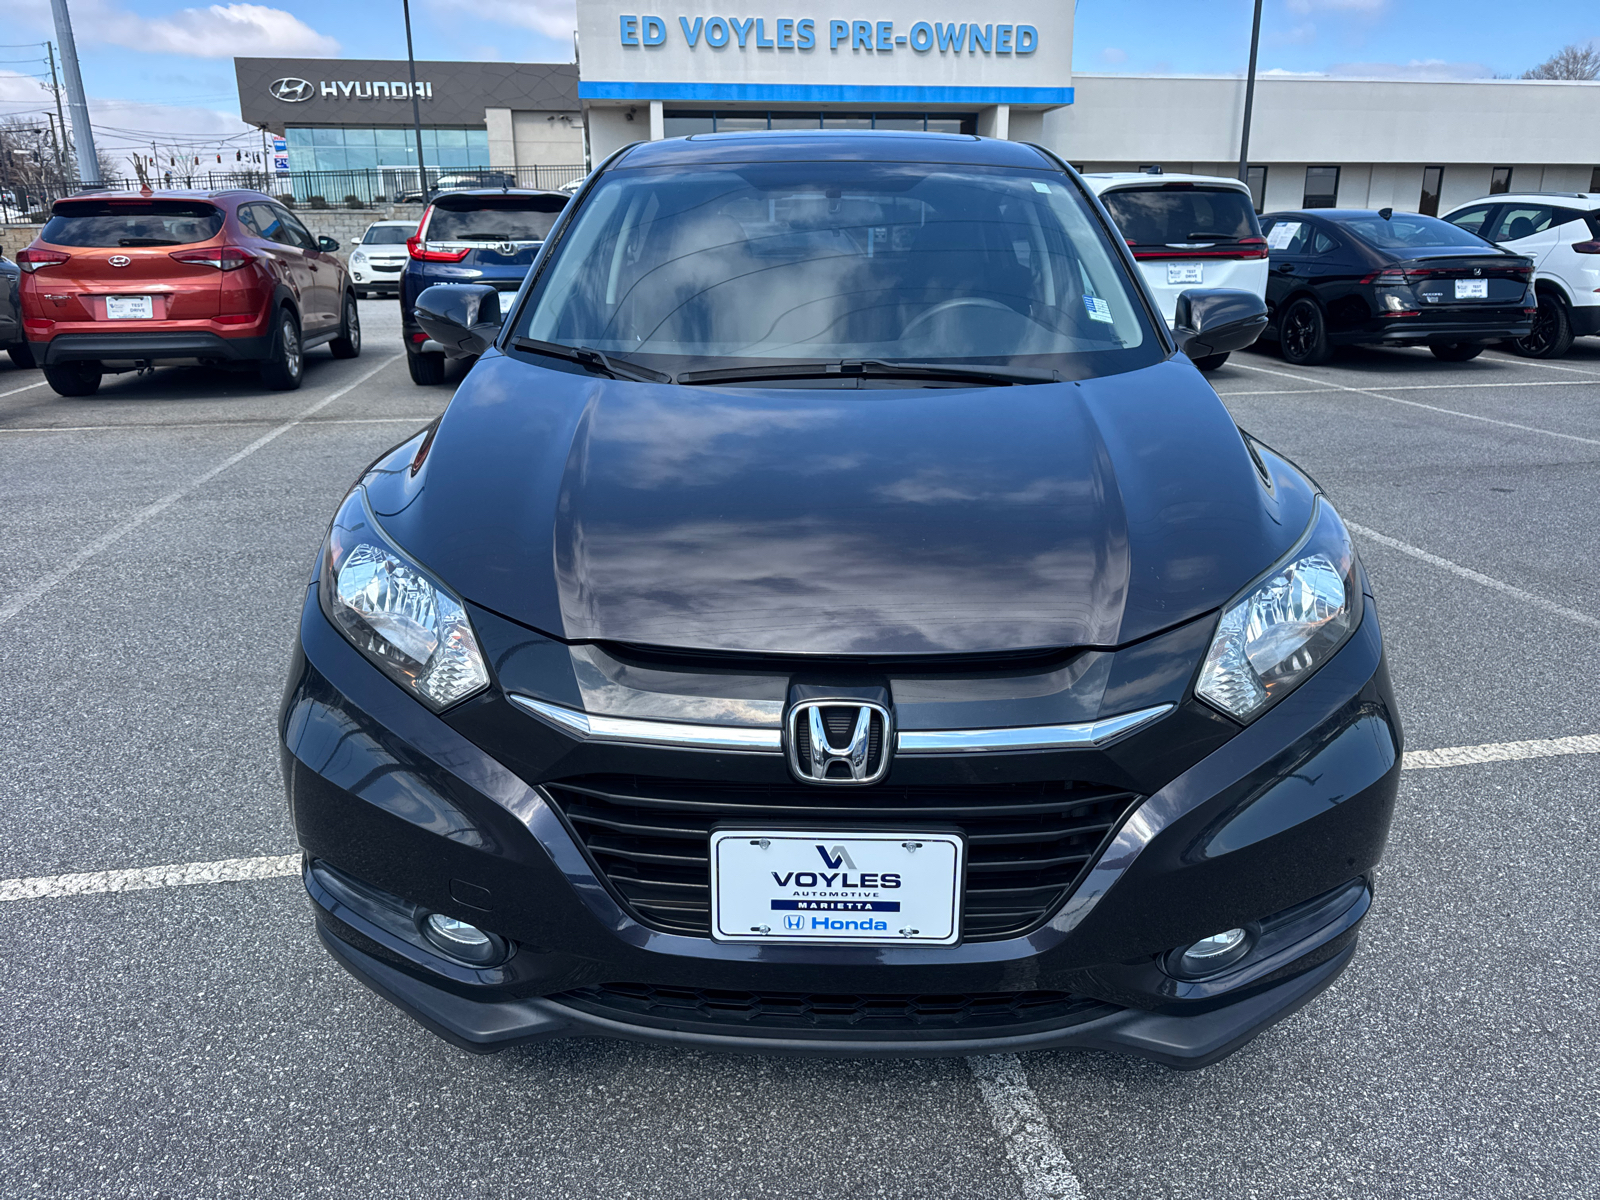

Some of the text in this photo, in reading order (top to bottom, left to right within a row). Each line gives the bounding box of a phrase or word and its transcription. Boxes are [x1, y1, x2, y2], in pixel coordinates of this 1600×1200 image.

[620, 15, 1039, 53] ED VOYLES PRE-OWNED
[320, 81, 433, 99] HYUNDAI
[771, 871, 901, 889] VOYLES
[798, 902, 873, 910] MARIETTA
[811, 917, 888, 931] Honda
